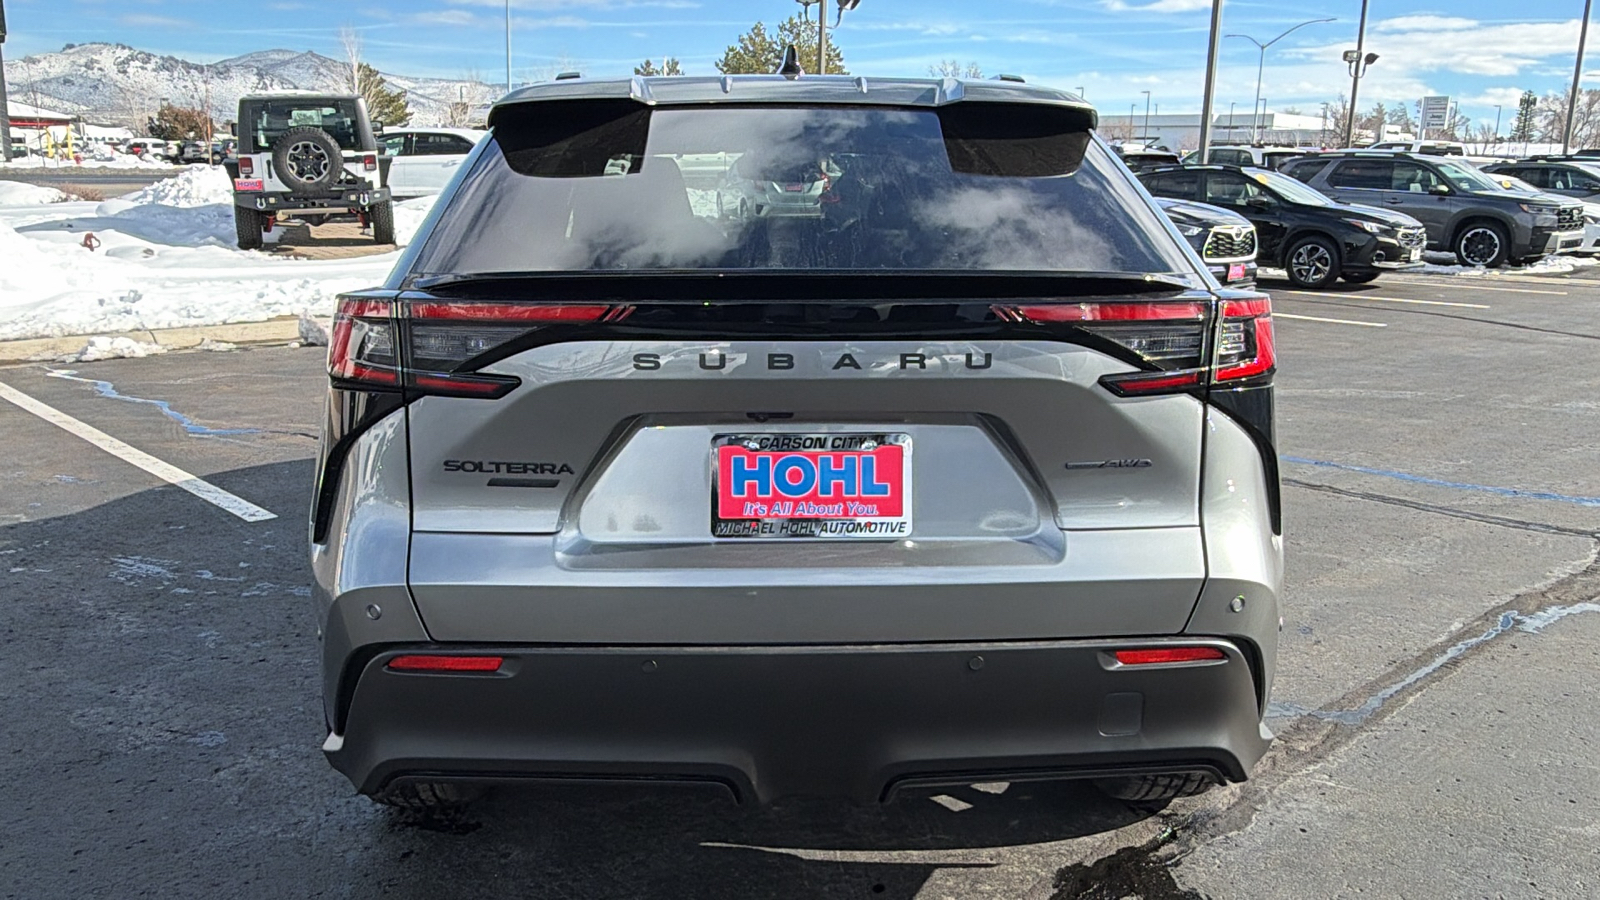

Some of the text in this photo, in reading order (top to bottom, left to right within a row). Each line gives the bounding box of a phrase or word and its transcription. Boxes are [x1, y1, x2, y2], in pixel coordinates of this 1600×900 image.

[632, 352, 992, 371] SUBARU
[759, 437, 868, 449] CARSON CITY
[443, 460, 575, 475] SOLTERRA
[1103, 458, 1152, 468] AWD
[731, 455, 891, 497] HOHL
[743, 502, 879, 515] It's All About You.
[715, 521, 907, 535] MICHAEL HOHL AUTOMOTIVE
